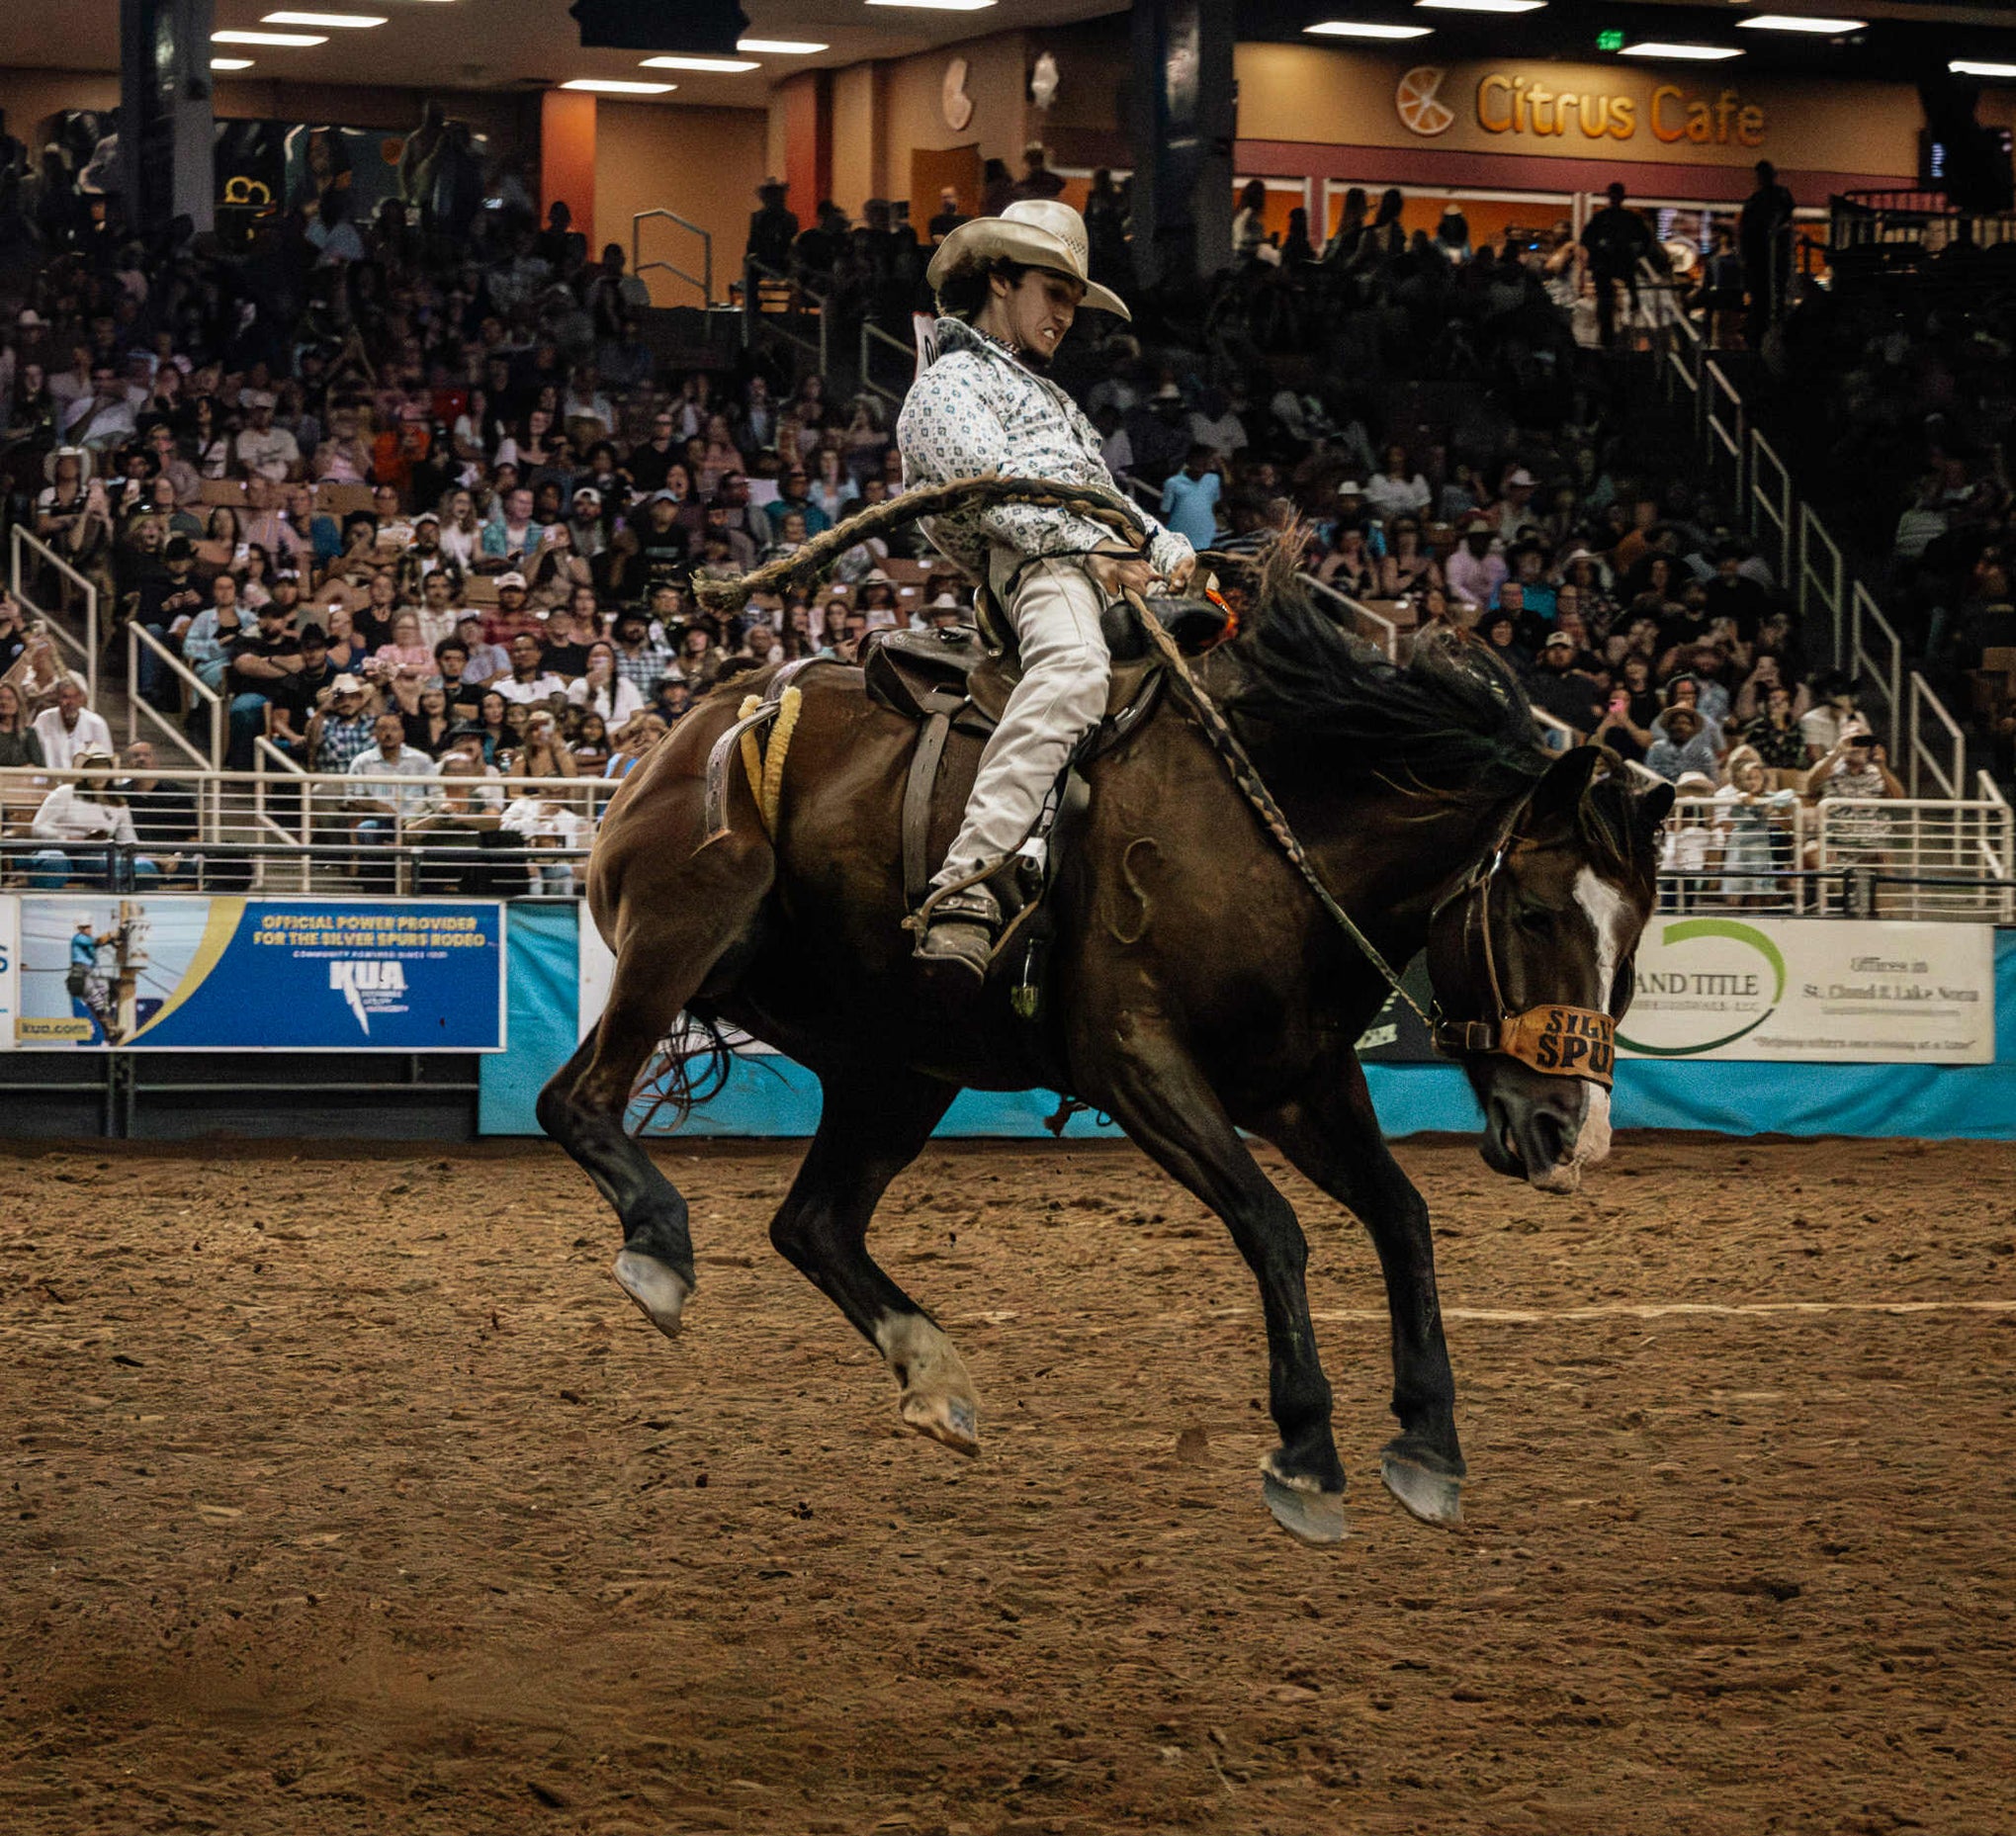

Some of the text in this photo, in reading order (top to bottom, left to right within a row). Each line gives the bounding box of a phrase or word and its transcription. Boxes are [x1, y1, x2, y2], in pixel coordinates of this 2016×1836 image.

[1477, 74, 1766, 146] Citrus Cafe
[262, 916, 478, 930] OFFICIAL POWER PROVIDER
[253, 931, 285, 945] FOR
[289, 931, 318, 945] THE
[321, 932, 375, 946] SILVER
[377, 932, 427, 947] SPURS
[430, 933, 485, 947] RODEO
[329, 960, 403, 990] KUA
[1690, 974, 1758, 996] TITLE
[21, 1022, 88, 1034] kua.com
